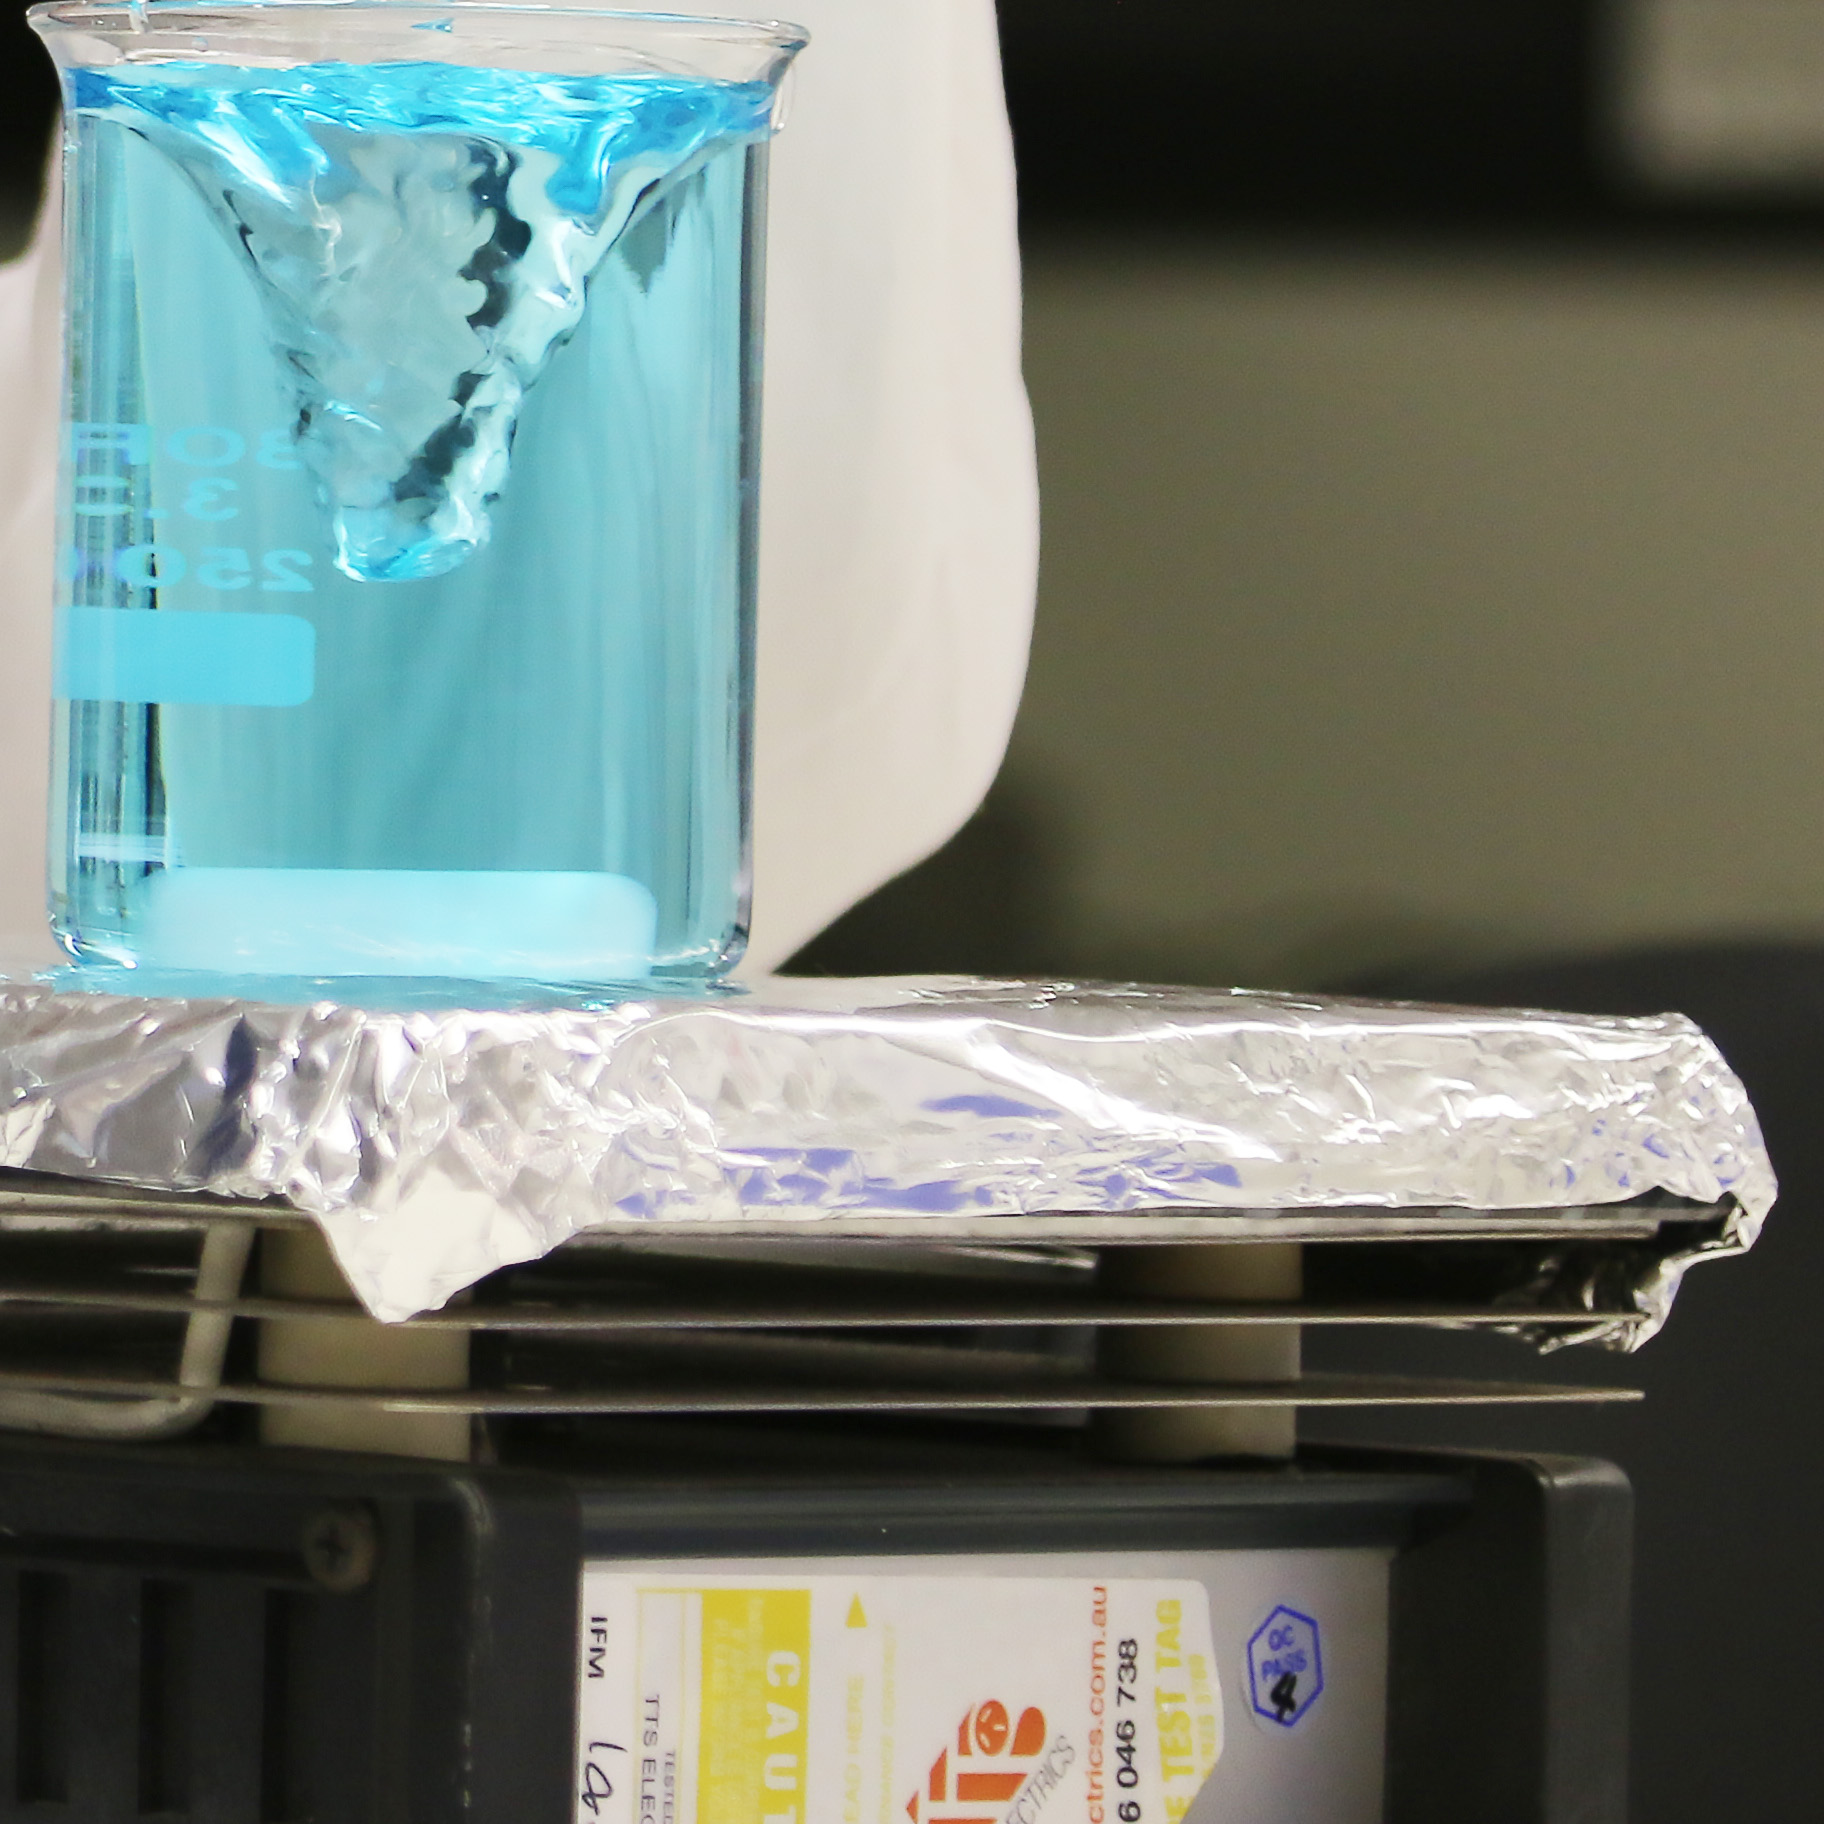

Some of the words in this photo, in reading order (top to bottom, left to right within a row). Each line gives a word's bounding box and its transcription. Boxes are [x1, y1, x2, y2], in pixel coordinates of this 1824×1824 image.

[587, 1615, 608, 1679] IFM
[1155, 1598, 1183, 1674] TAG
[1116, 1638, 1139, 1708] 738
[1269, 1671, 1297, 1723] 4
[642, 1693, 660, 1747] TTS
[1116, 1717, 1139, 1789] 046
[1155, 1686, 1195, 1782] TEST
[1118, 1800, 1141, 1823] 6
